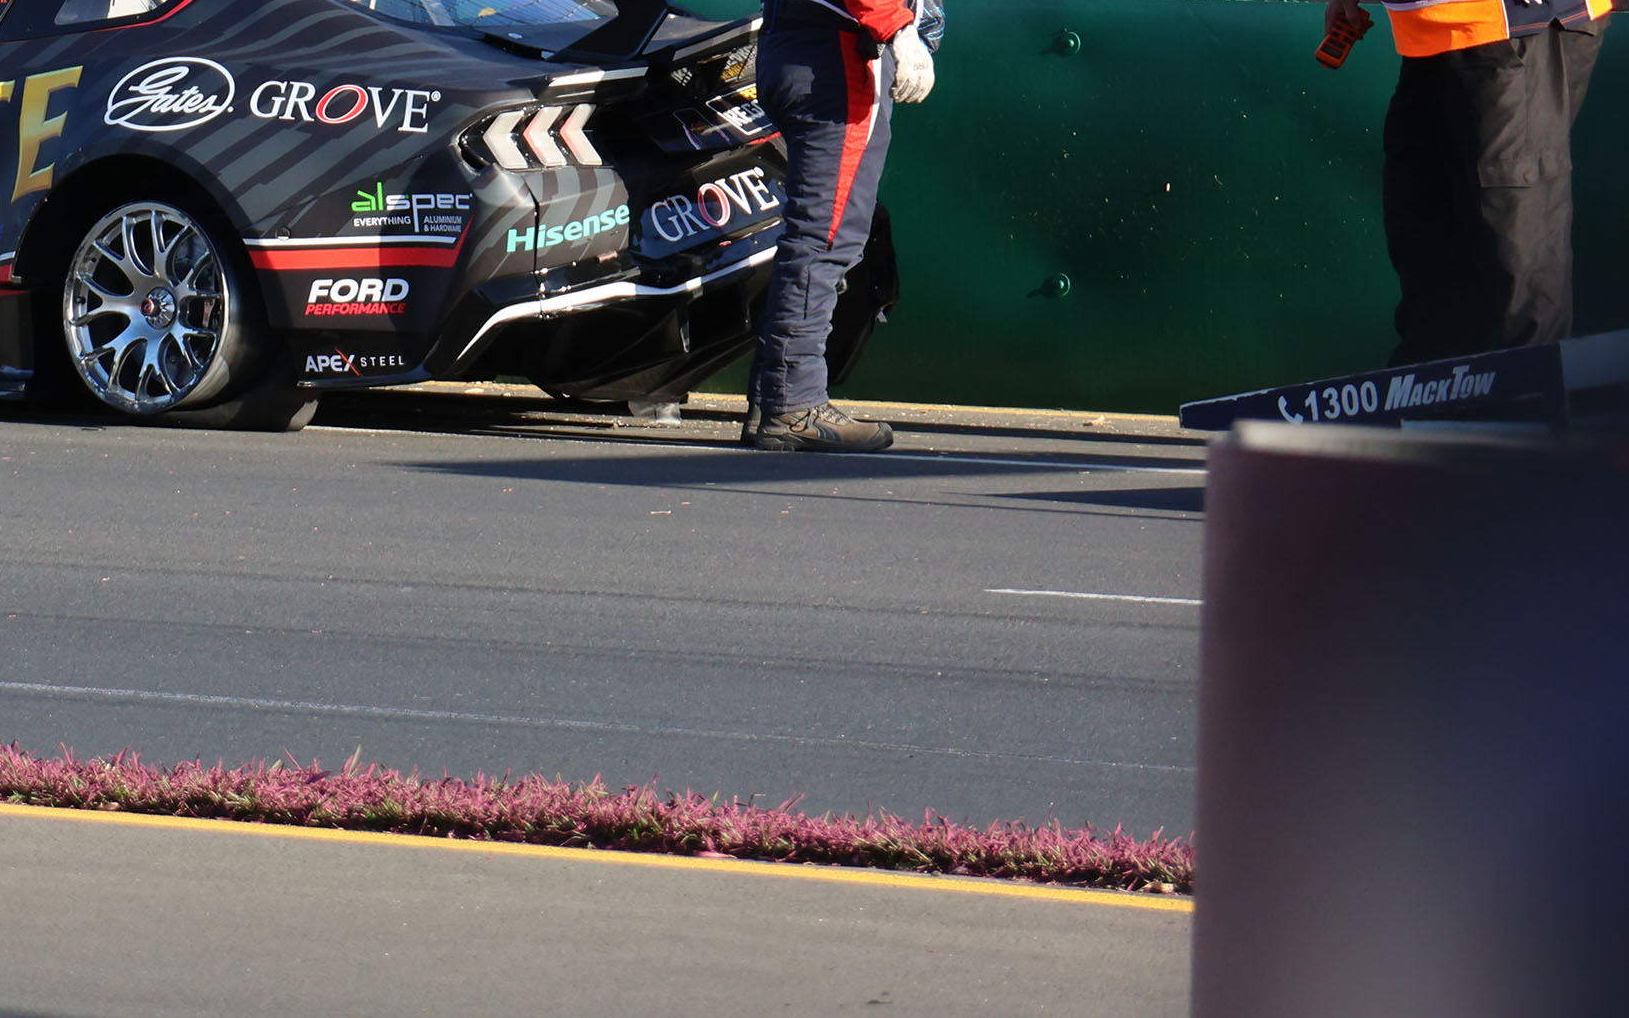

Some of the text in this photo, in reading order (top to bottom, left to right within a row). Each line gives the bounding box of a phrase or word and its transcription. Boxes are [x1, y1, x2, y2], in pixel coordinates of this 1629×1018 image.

[353, 215, 412, 227] EVERYTHING
[423, 215, 462, 224] ALUMINIUM
[430, 224, 462, 233] HARDWARE
[506, 202, 631, 254] Hisense
[307, 278, 410, 304] FORD
[304, 302, 408, 317] PERFORMANCE
[304, 348, 405, 376] APEX STEEL
[1304, 381, 1380, 422] 1300
